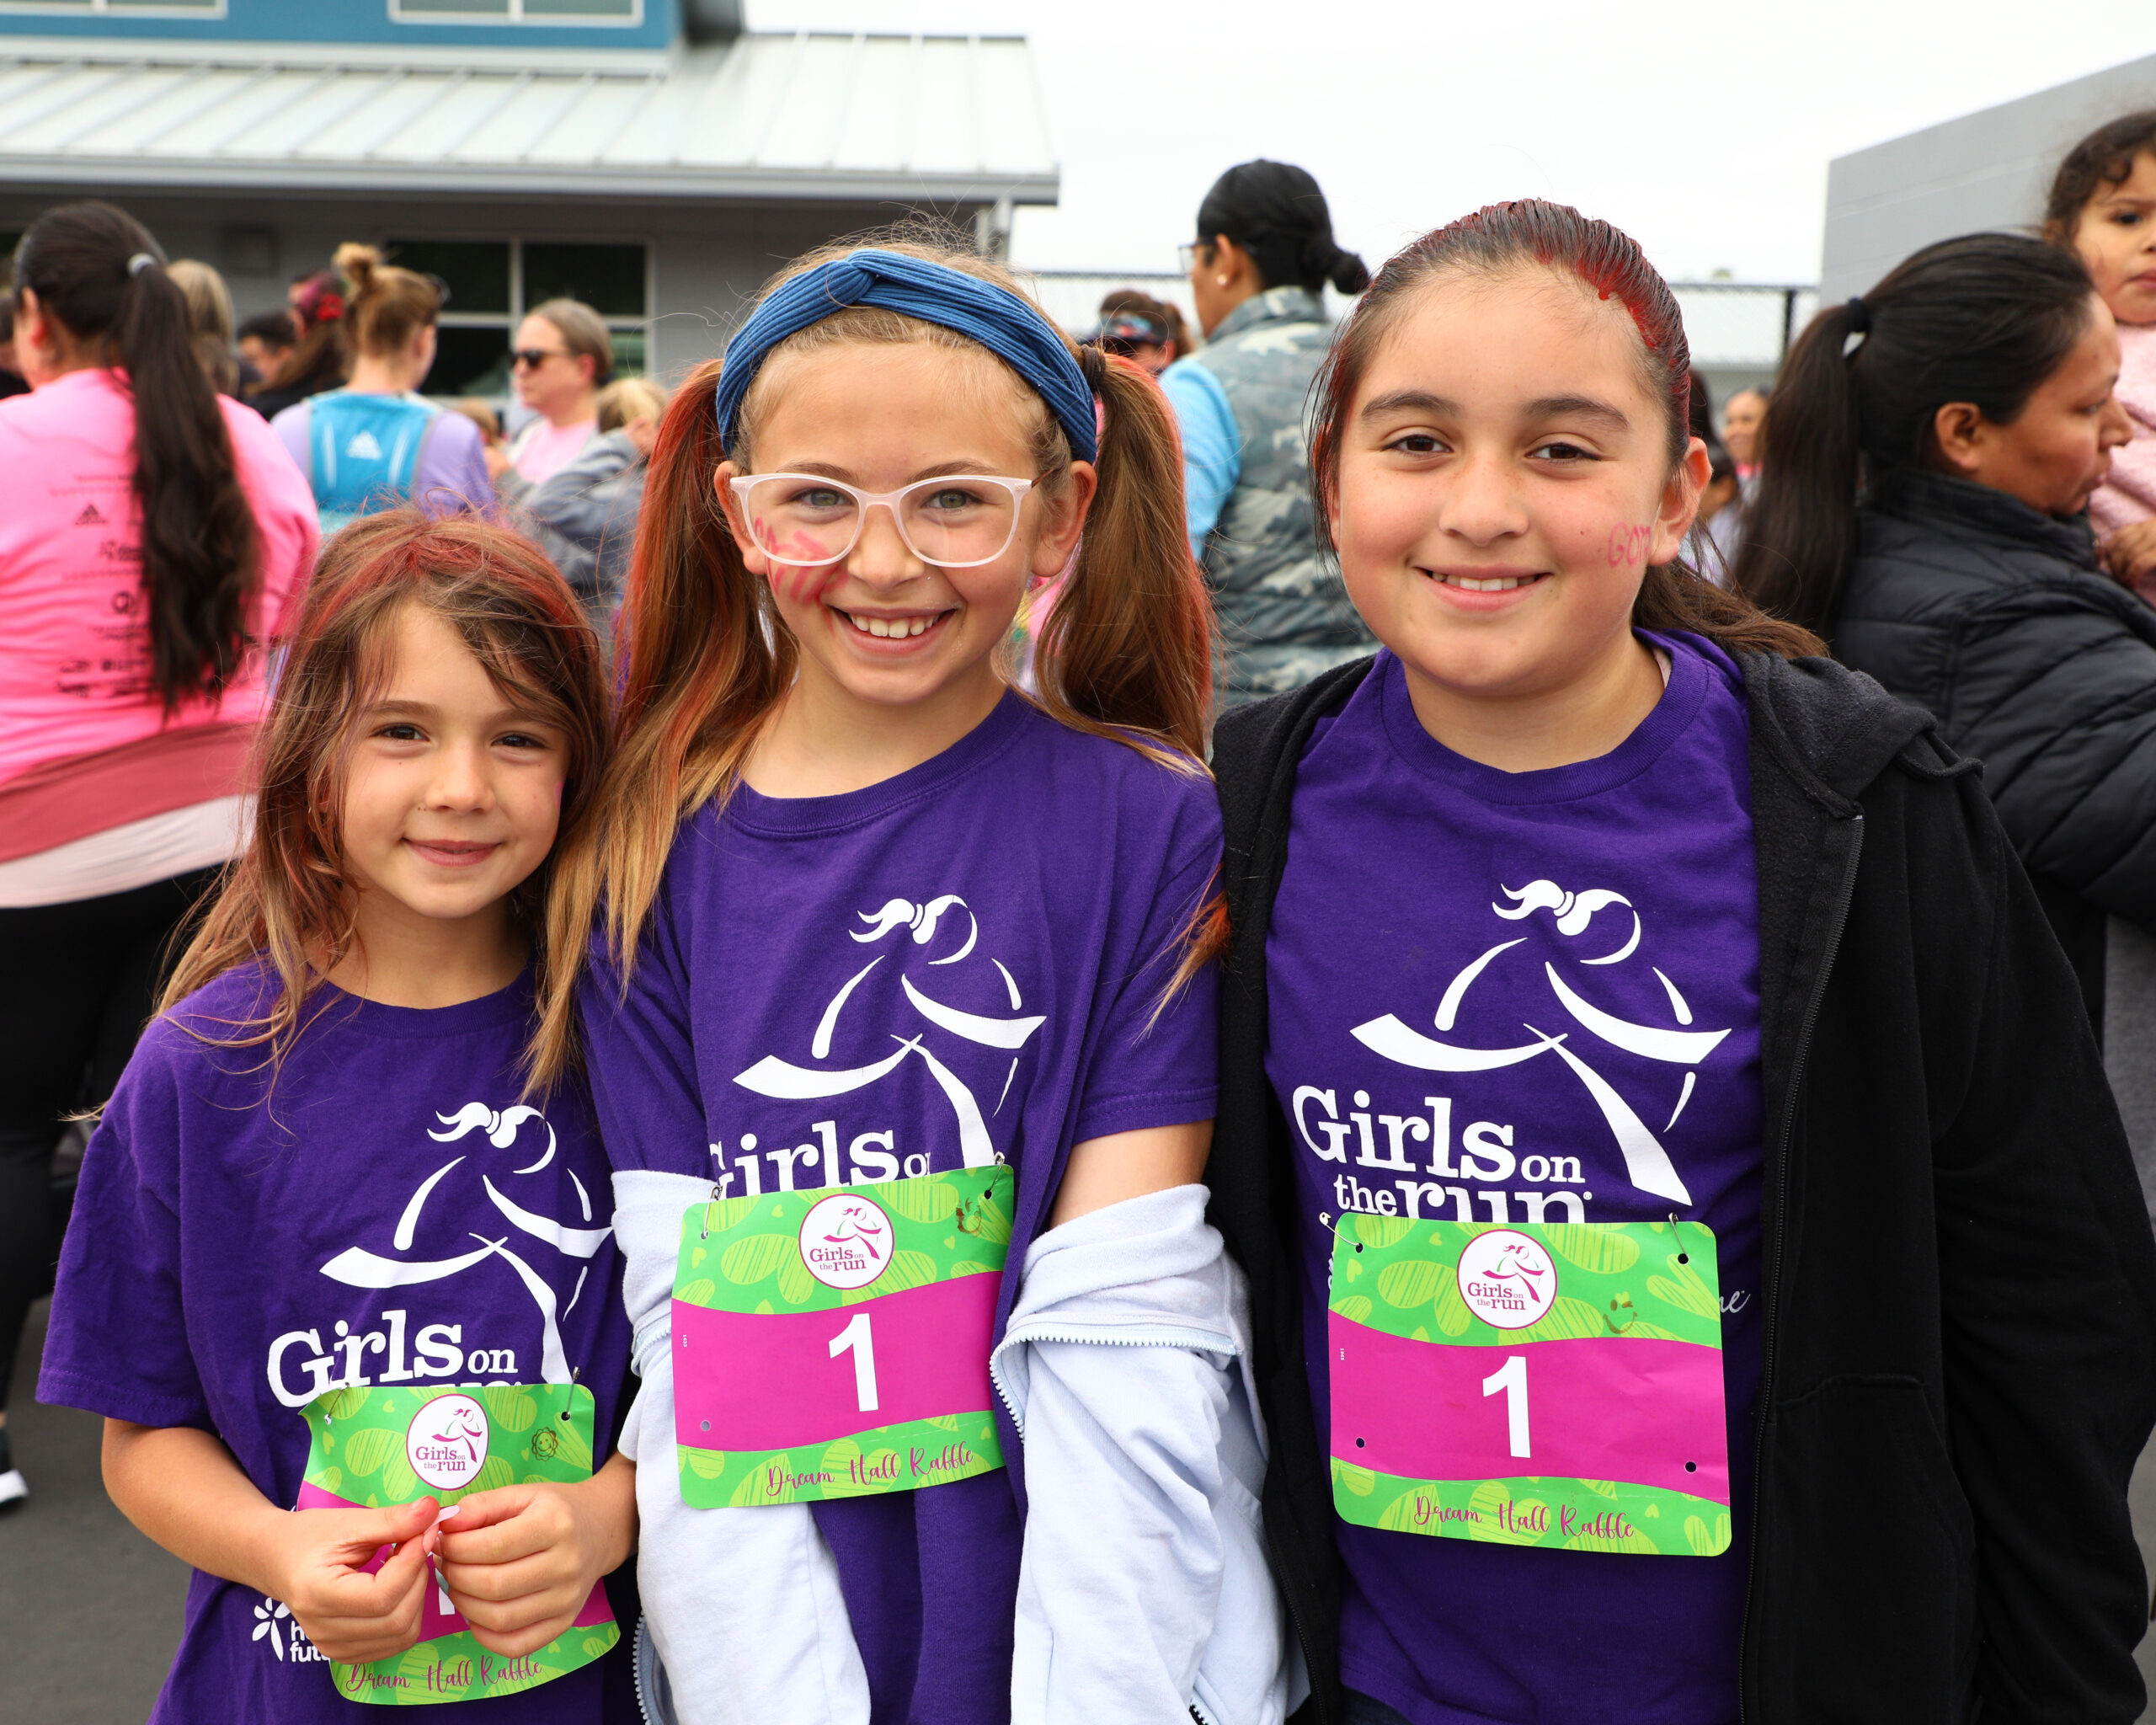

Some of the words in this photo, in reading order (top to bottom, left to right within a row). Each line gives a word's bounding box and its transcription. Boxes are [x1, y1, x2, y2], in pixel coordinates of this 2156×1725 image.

[1293, 1085, 1517, 1182] Girls
[1521, 1155, 1586, 1183] on
[1333, 1174, 1398, 1216] the
[809, 1247, 853, 1262] Girls
[833, 1258, 867, 1271] run
[1467, 1282, 1513, 1298] Girls
[1491, 1299, 1526, 1311] run
[267, 1309, 464, 1408] Girls
[467, 1349, 519, 1375] on
[828, 1313, 879, 1412] 1
[1482, 1355, 1531, 1458] 1
[415, 1446, 457, 1461] Girls
[436, 1461, 467, 1471] run
[766, 1466, 835, 1497] Dream
[844, 1453, 901, 1486] Hall
[910, 1441, 974, 1477] Raffle
[1413, 1496, 1483, 1525] Dream
[1492, 1499, 1550, 1535] Hall
[1561, 1504, 1635, 1540] Raffle
[345, 1664, 411, 1692] Dream
[422, 1659, 473, 1693] Hall
[480, 1654, 542, 1685] Raffle
